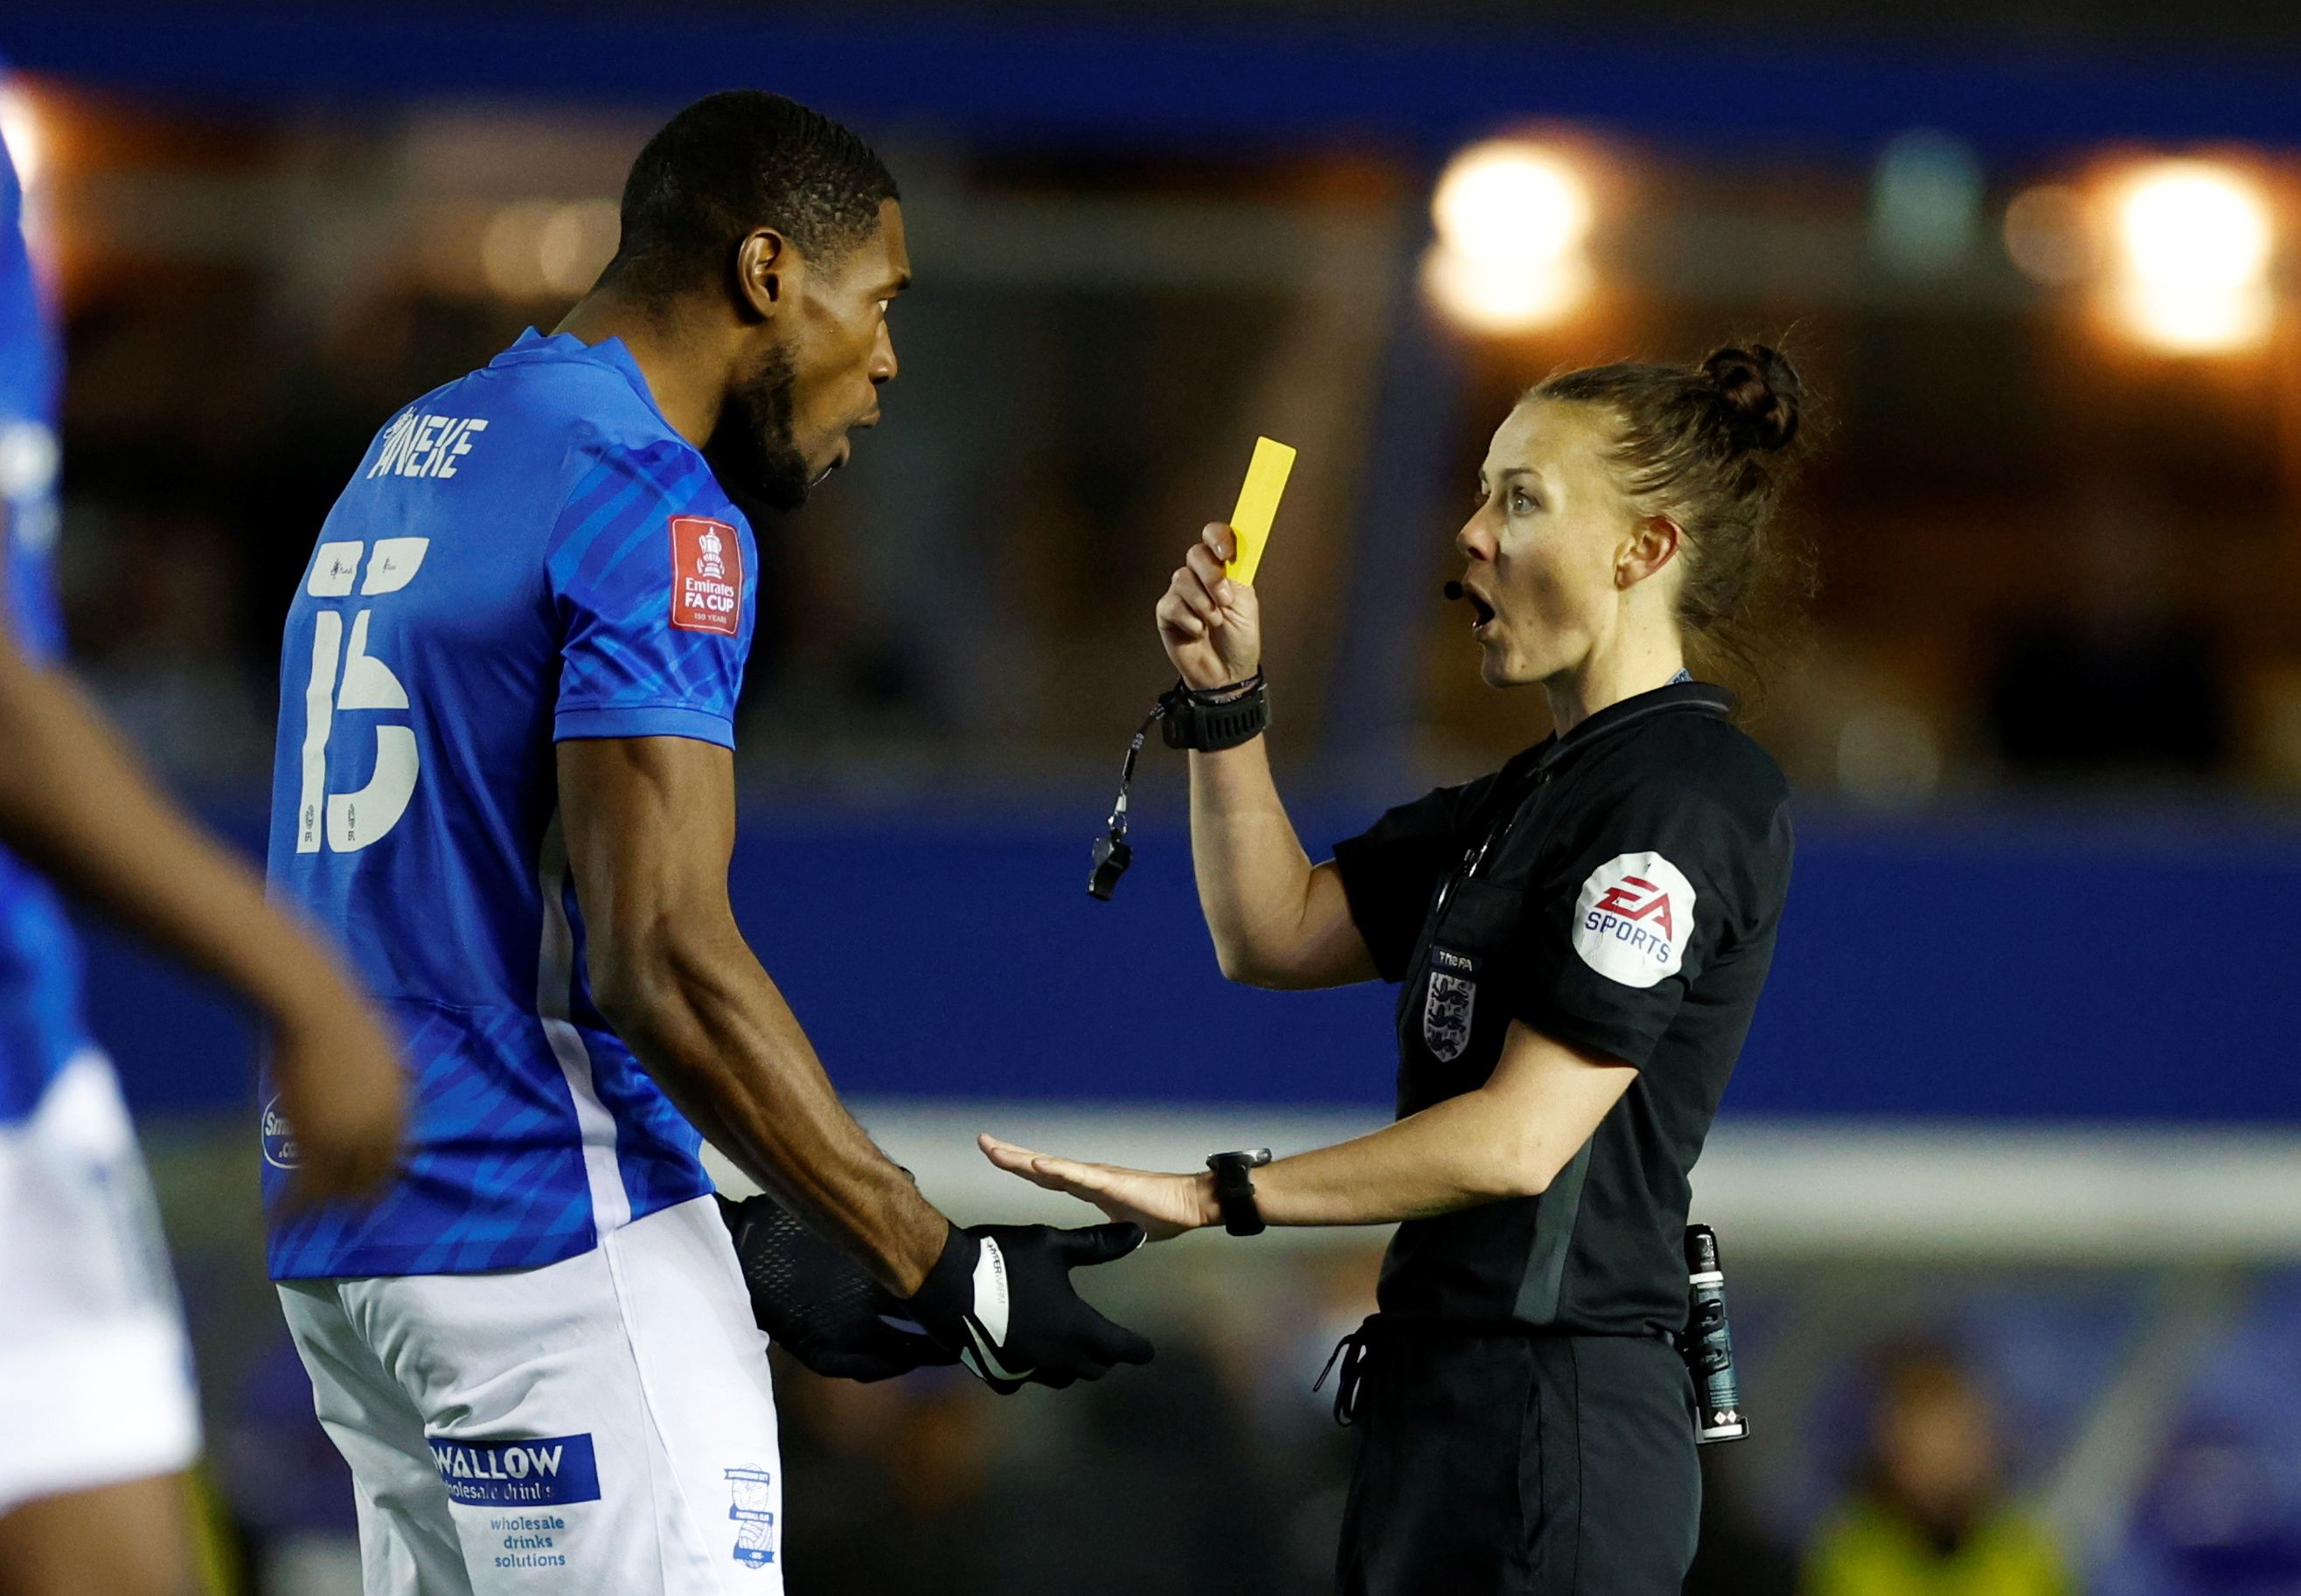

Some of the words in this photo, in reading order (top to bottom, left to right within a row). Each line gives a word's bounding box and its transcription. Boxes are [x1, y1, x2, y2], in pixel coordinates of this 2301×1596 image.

[366, 406, 489, 479] ANEKE
[685, 577, 734, 598] Emirates
[685, 592, 705, 609] FA
[706, 594, 734, 613] CUP
[1594, 875, 1672, 943] EA
[1584, 911, 1672, 963] SPORTS
[429, 1444, 563, 1480] WALLOW
[490, 1515, 565, 1530] wholesale
[504, 1534, 553, 1549] drinks
[495, 1553, 566, 1568] solutions
